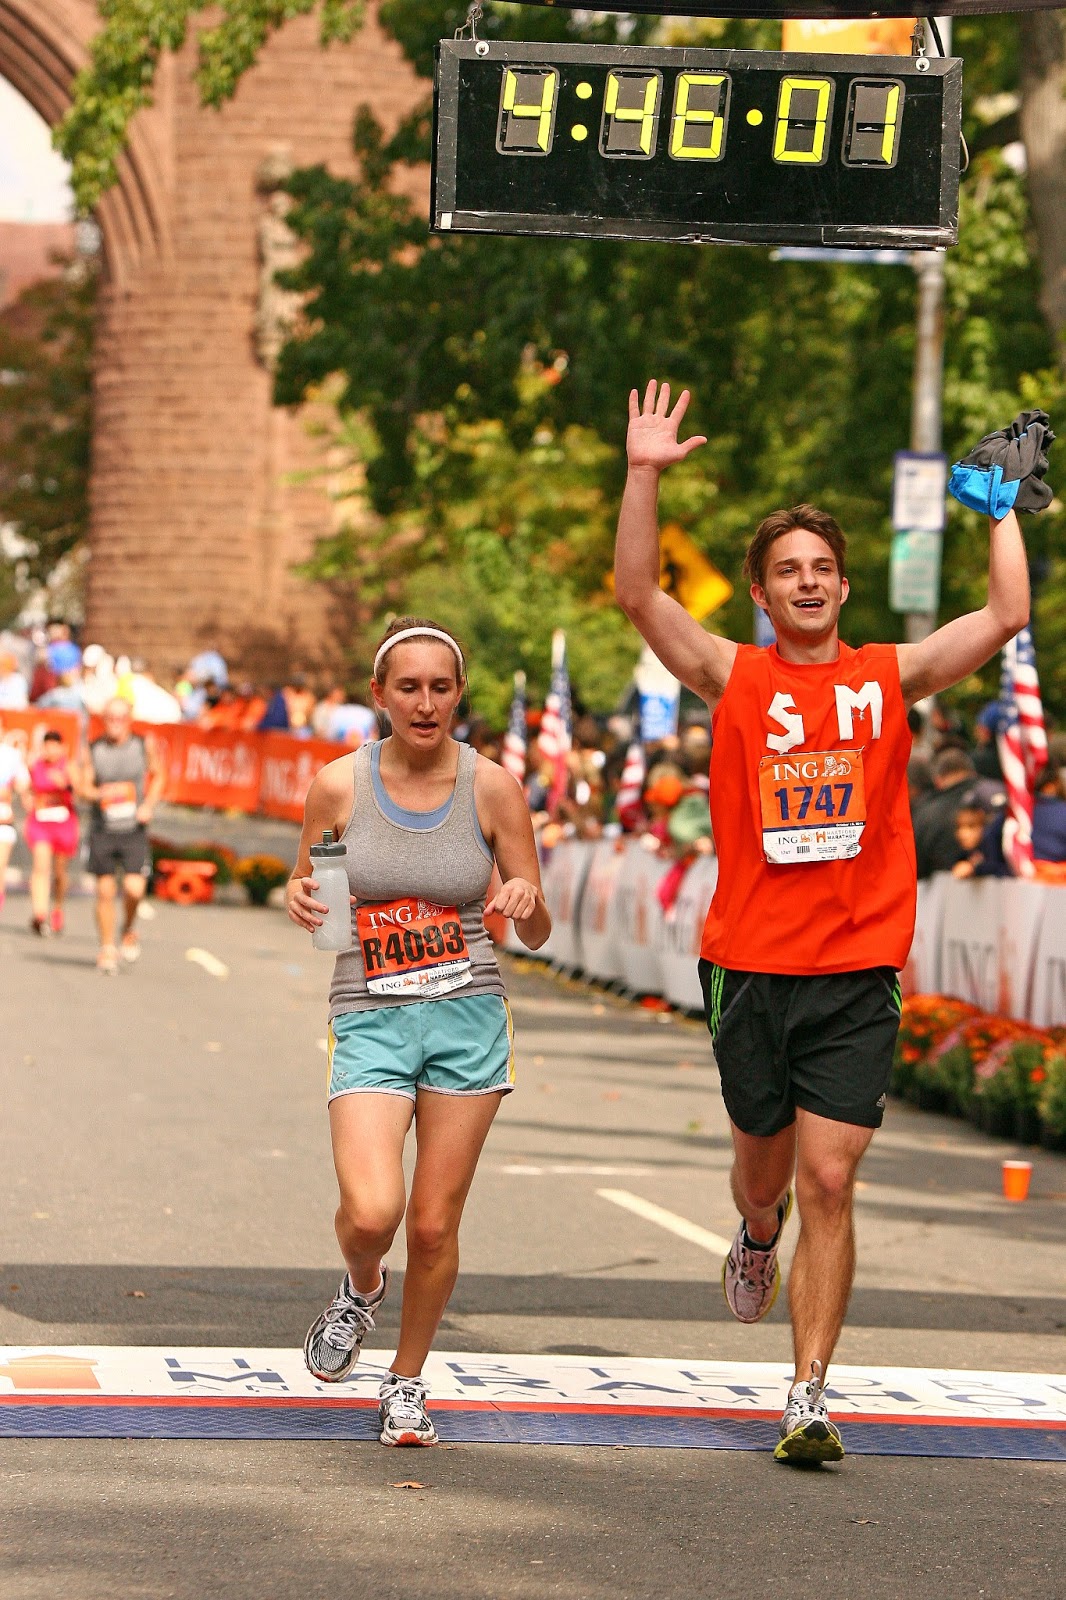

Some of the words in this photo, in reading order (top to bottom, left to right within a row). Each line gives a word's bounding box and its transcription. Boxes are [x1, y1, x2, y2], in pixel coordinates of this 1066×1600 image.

[772, 761, 818, 781] ING
[775, 782, 854, 821] 1747
[778, 836, 798, 845] ING
[368, 905, 413, 930] ING
[363, 921, 465, 972] R4093
[381, 982, 401, 992] ING
[167, 1370, 1048, 1407] MARATHO
